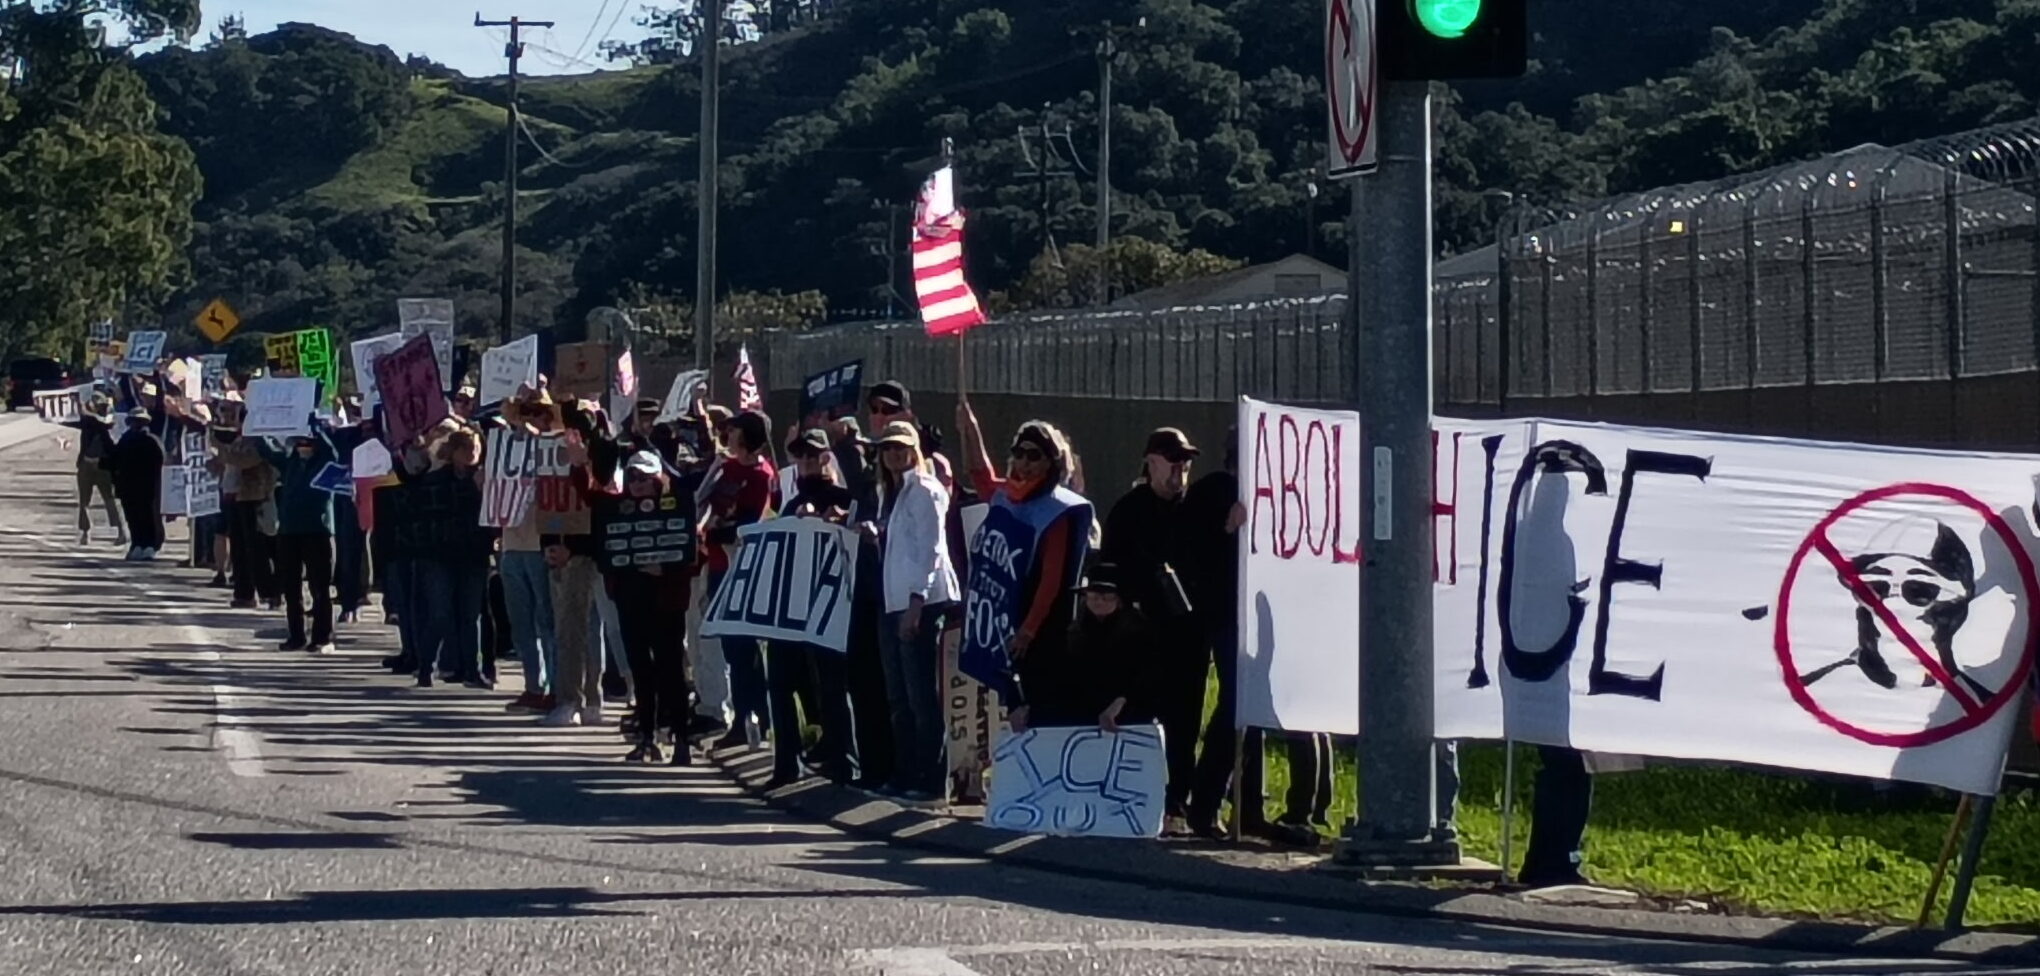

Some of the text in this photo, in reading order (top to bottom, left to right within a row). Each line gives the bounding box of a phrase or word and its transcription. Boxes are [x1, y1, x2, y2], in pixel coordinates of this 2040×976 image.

[1251, 412, 1715, 703] ABOLH ICE
[950, 675, 968, 742] STOP
[994, 727, 1159, 804] ICE
[991, 799, 1146, 837] OUT
